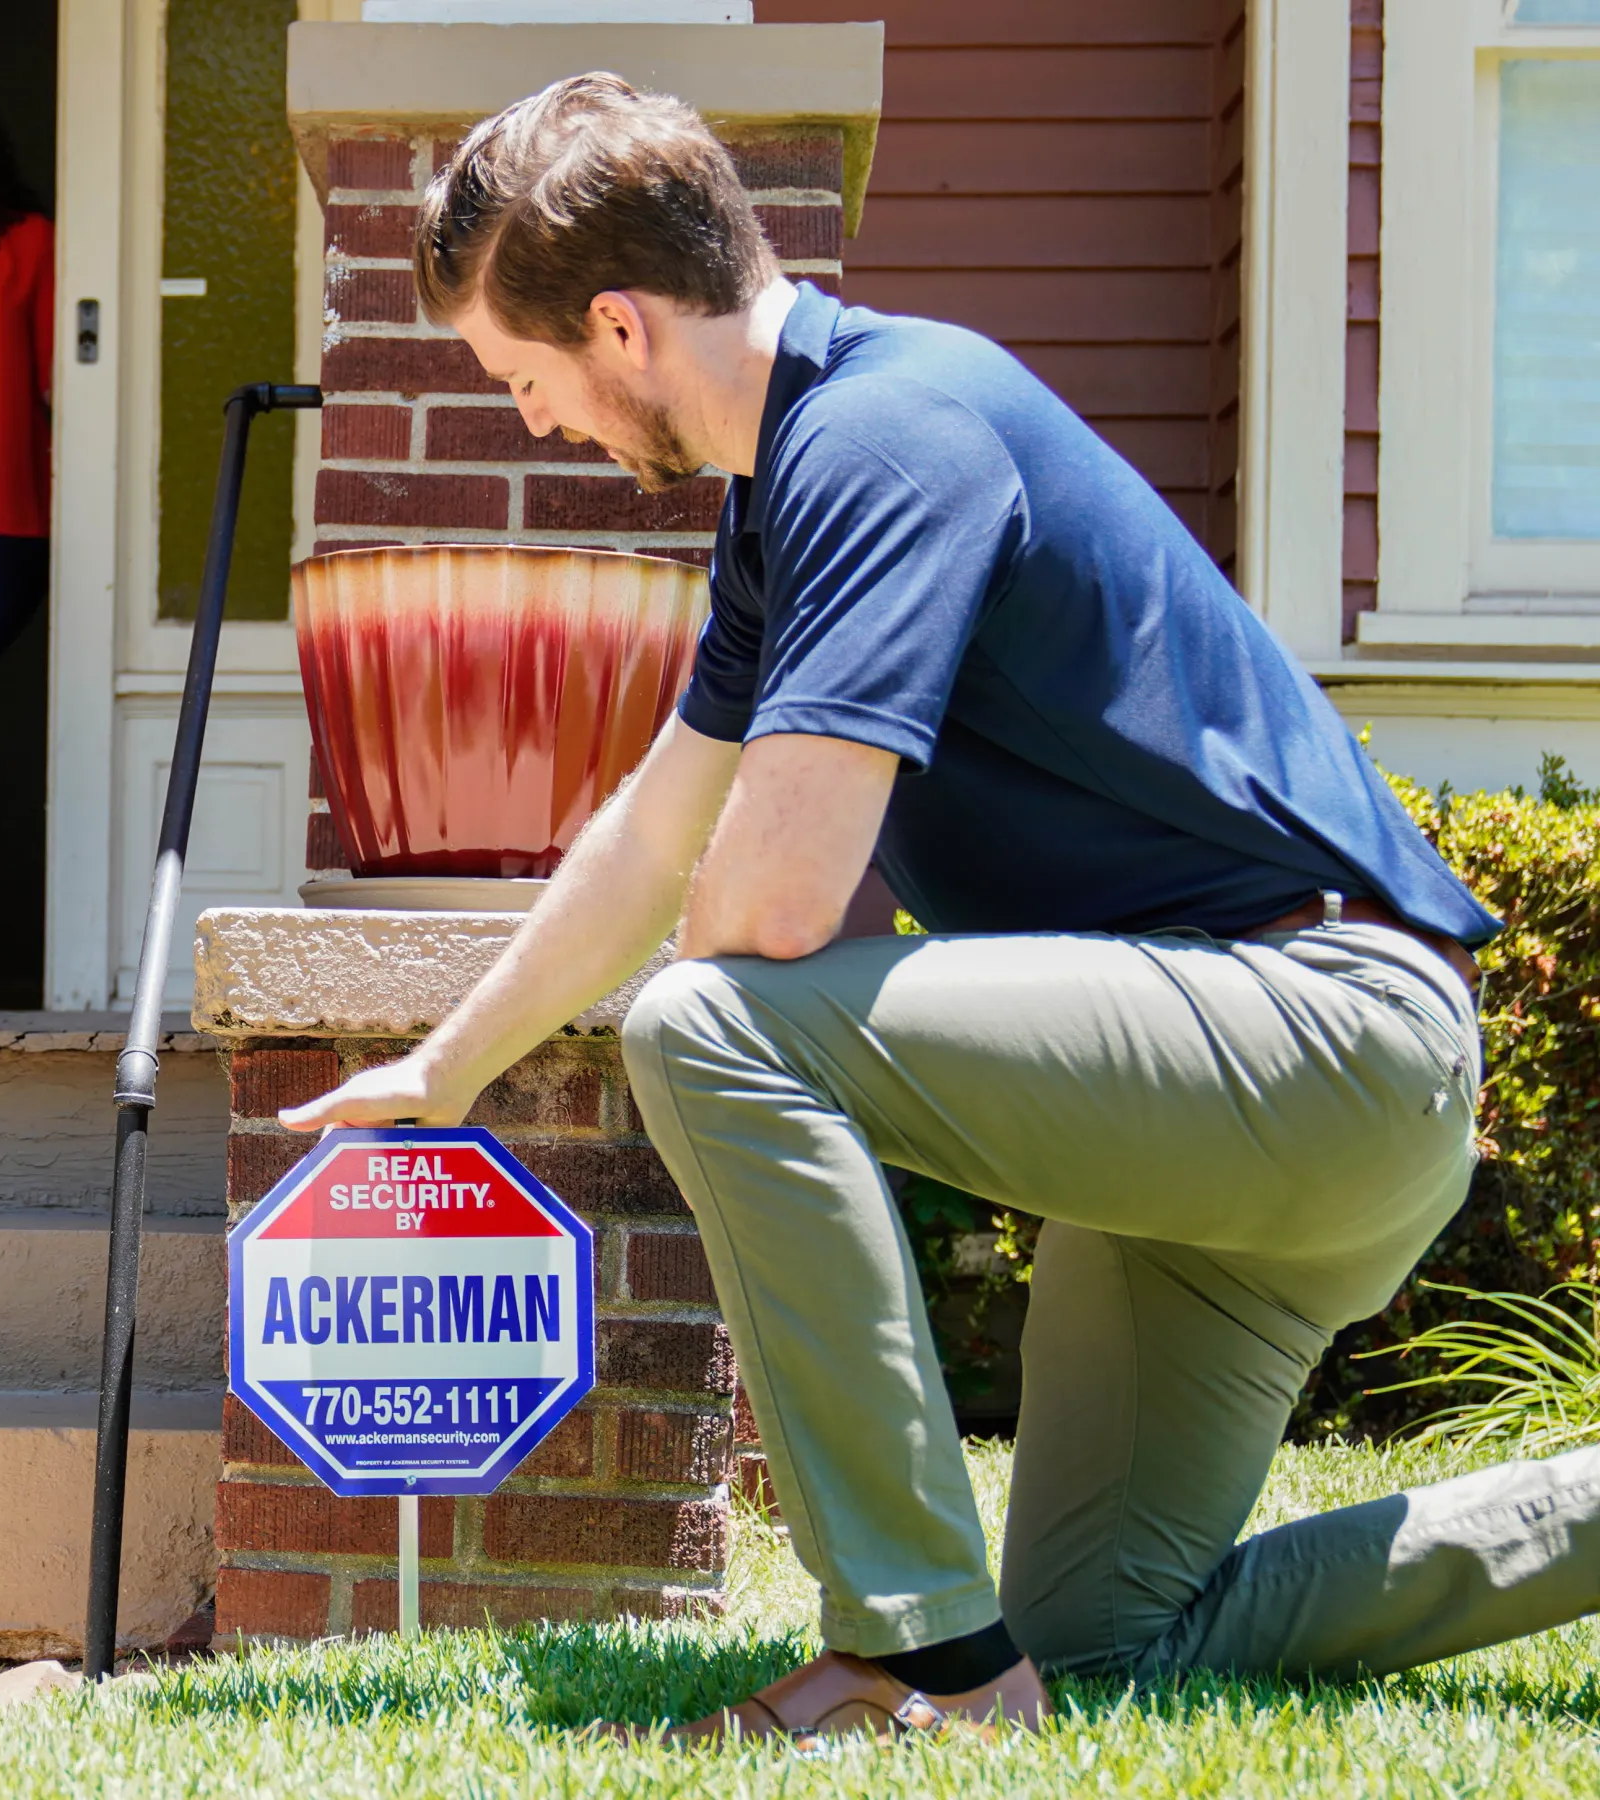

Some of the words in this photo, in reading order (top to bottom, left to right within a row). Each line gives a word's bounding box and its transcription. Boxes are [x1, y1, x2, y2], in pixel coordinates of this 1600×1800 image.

[368, 1156, 452, 1181] REAL
[395, 1212, 425, 1231] BY
[262, 1274, 560, 1345] ACKERMAN
[302, 1385, 519, 1425] 770-552-1111
[325, 1431, 500, 1446] www.ackermansecurity.com
